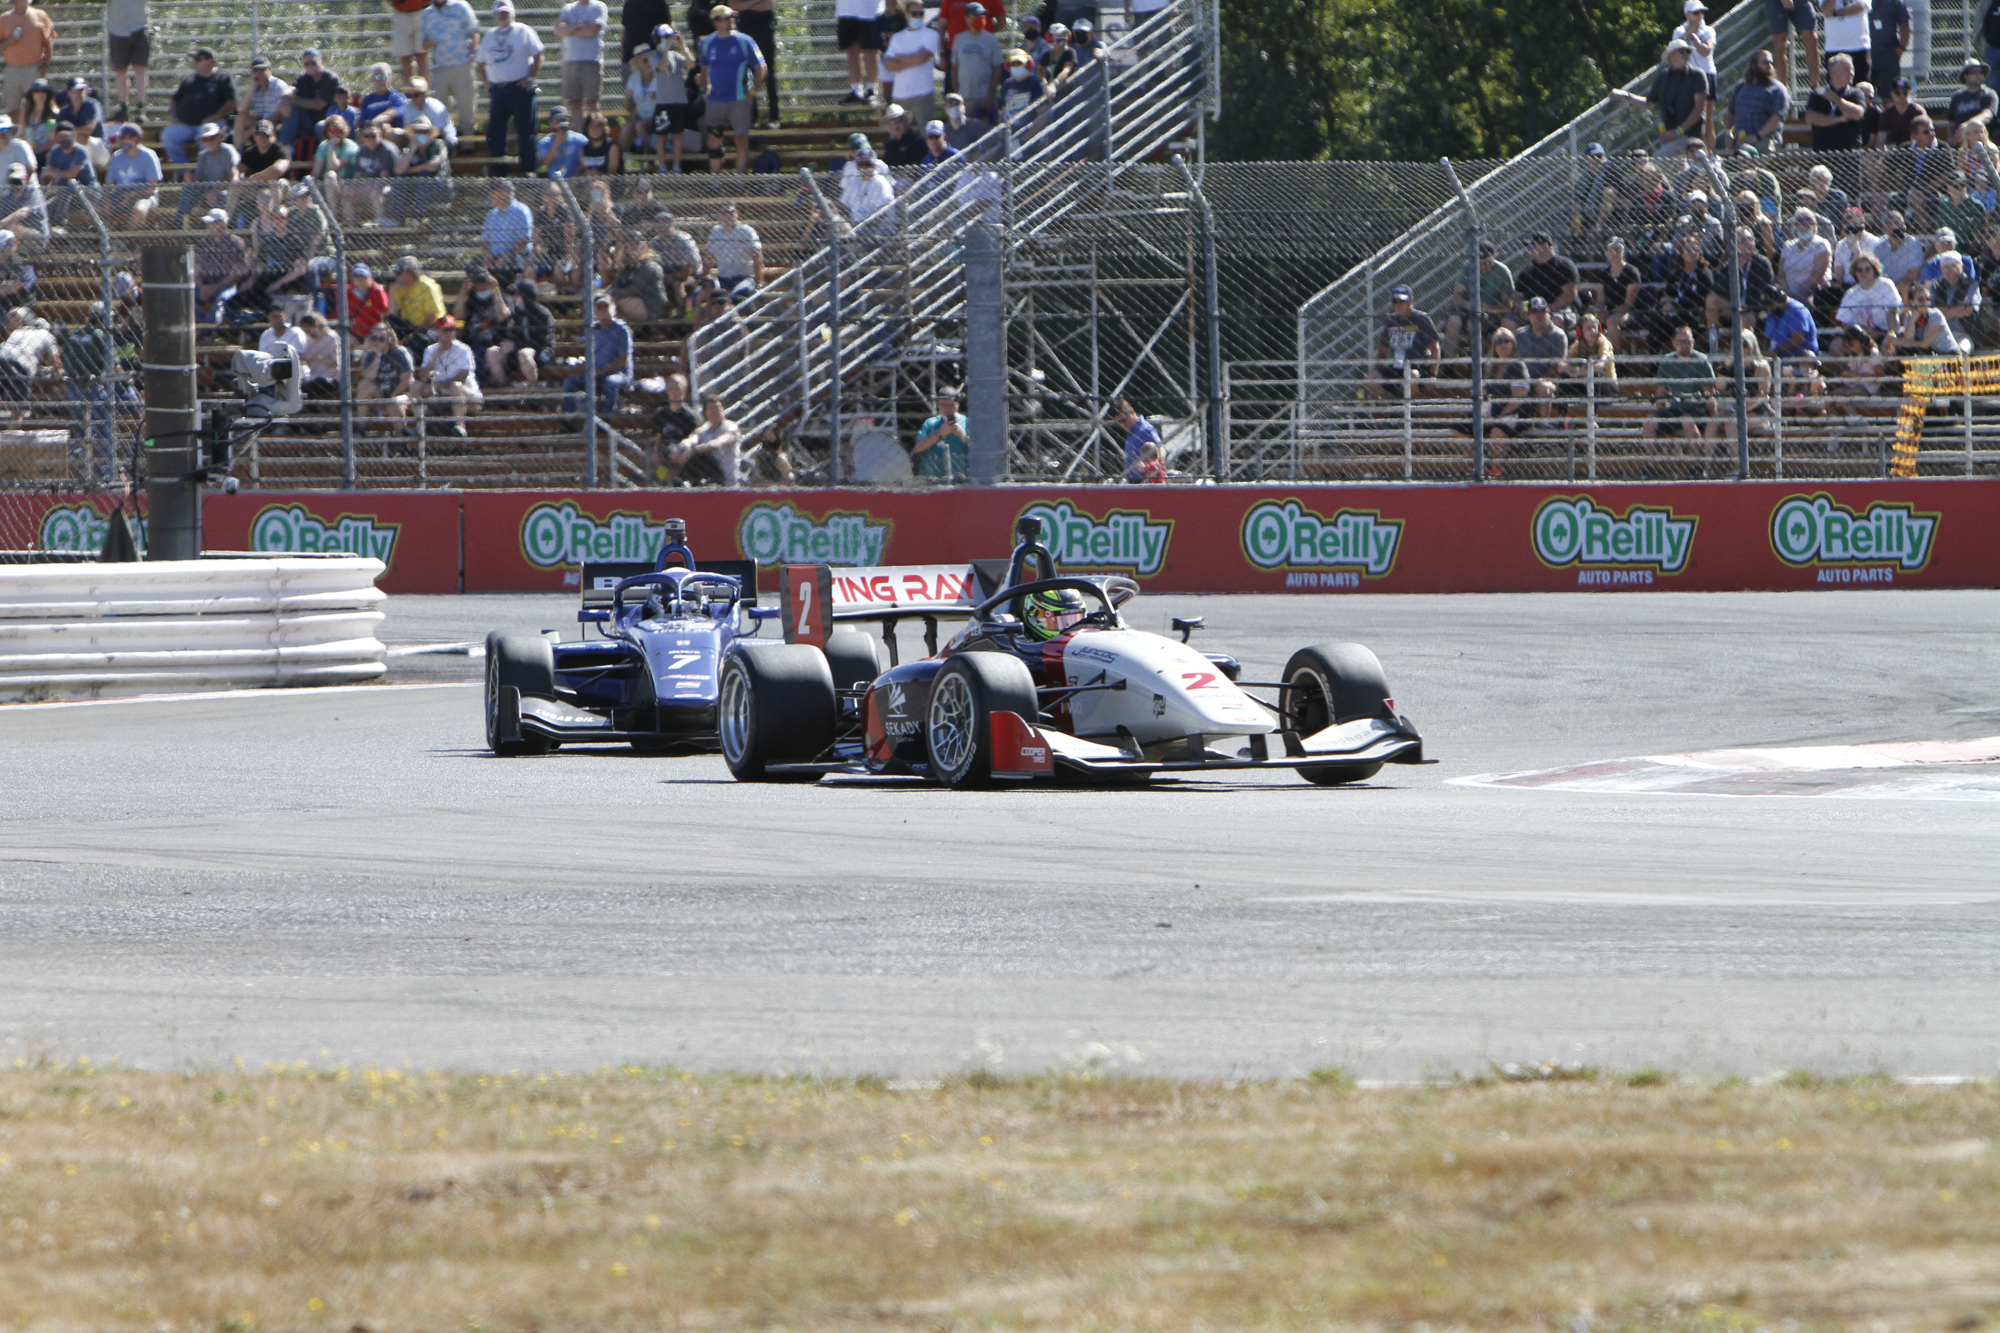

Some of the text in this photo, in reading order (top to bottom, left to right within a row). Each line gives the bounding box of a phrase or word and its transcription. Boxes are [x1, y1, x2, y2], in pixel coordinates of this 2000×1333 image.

[259, 513, 389, 559] O'Reilly
[529, 511, 662, 563] O'Reilly
[746, 510, 879, 567] O'Reilly
[1250, 508, 1393, 567] O'Reilly
[1541, 504, 1687, 564] O'Reilly
[1778, 502, 1927, 562] O'Reilly
[831, 573, 975, 603] ING RAY
[1285, 572, 1360, 588] AUTO PARTS
[1578, 569, 1654, 585] AUTO PARTS
[1816, 567, 1894, 583] AUTO PARTS
[798, 581, 812, 635] 2
[667, 654, 702, 670] 7
[1181, 672, 1220, 691] 2
[534, 708, 573, 722] LUCAS
[885, 720, 922, 736] SEKADY
